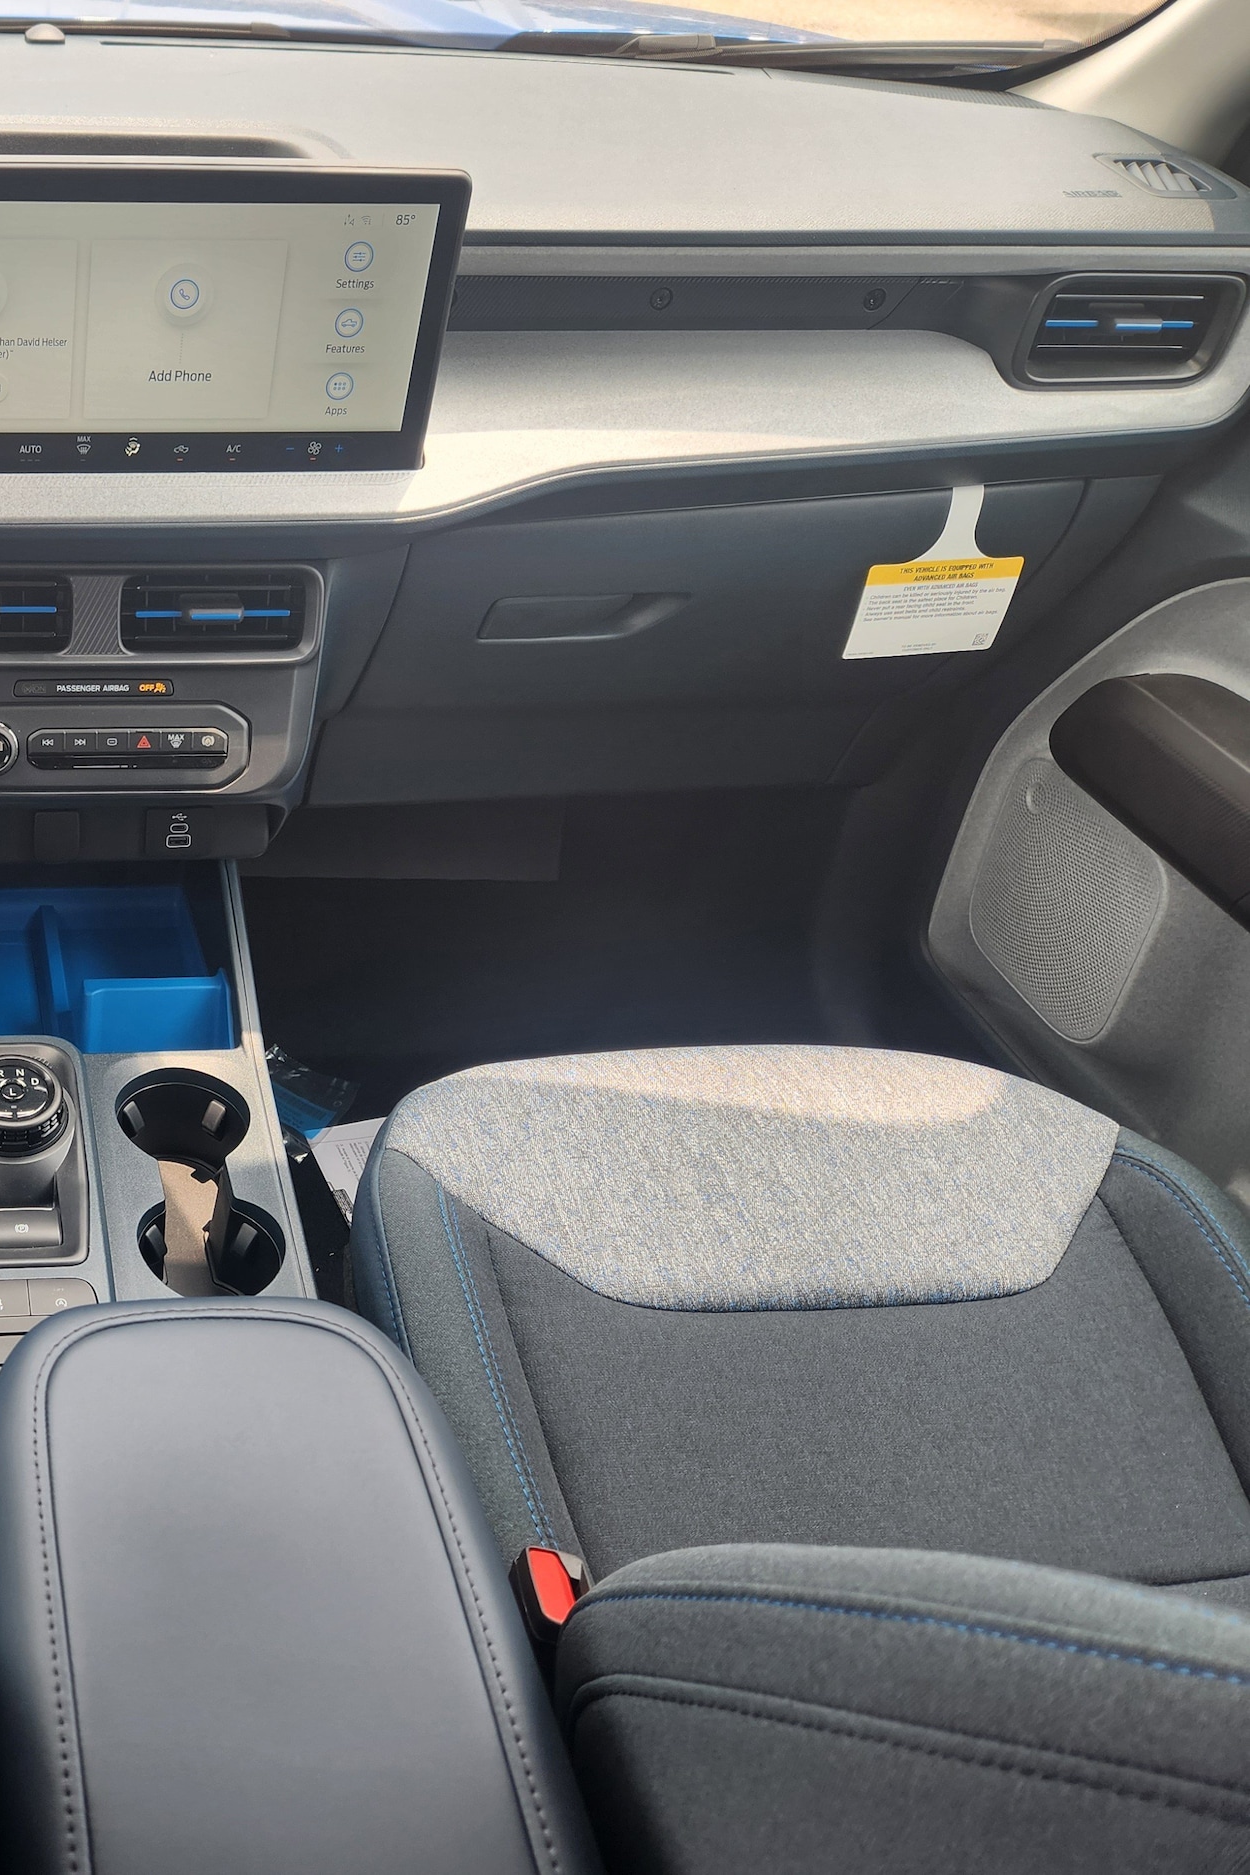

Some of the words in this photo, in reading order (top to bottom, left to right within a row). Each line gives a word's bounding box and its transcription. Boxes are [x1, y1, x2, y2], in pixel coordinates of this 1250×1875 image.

[395, 214, 416, 226] 85°
[336, 279, 374, 290] Settings
[17, 337, 40, 347] David
[42, 337, 68, 347] Helser
[325, 344, 365, 353] Features
[148, 370, 172, 382] Add
[175, 370, 212, 382] Phone
[325, 406, 347, 417] Apps
[20, 445, 42, 454] AUTO
[226, 444, 241, 453] A/C
[913, 574, 946, 582] ADVANCED
[56, 684, 101, 692] PASSENGER
[102, 684, 130, 692] AIRBAG
[139, 684, 155, 692] OFF
[15, 1069, 25, 1077] N
[31, 1078, 40, 1086] D
[9, 1088, 17, 1096] L
